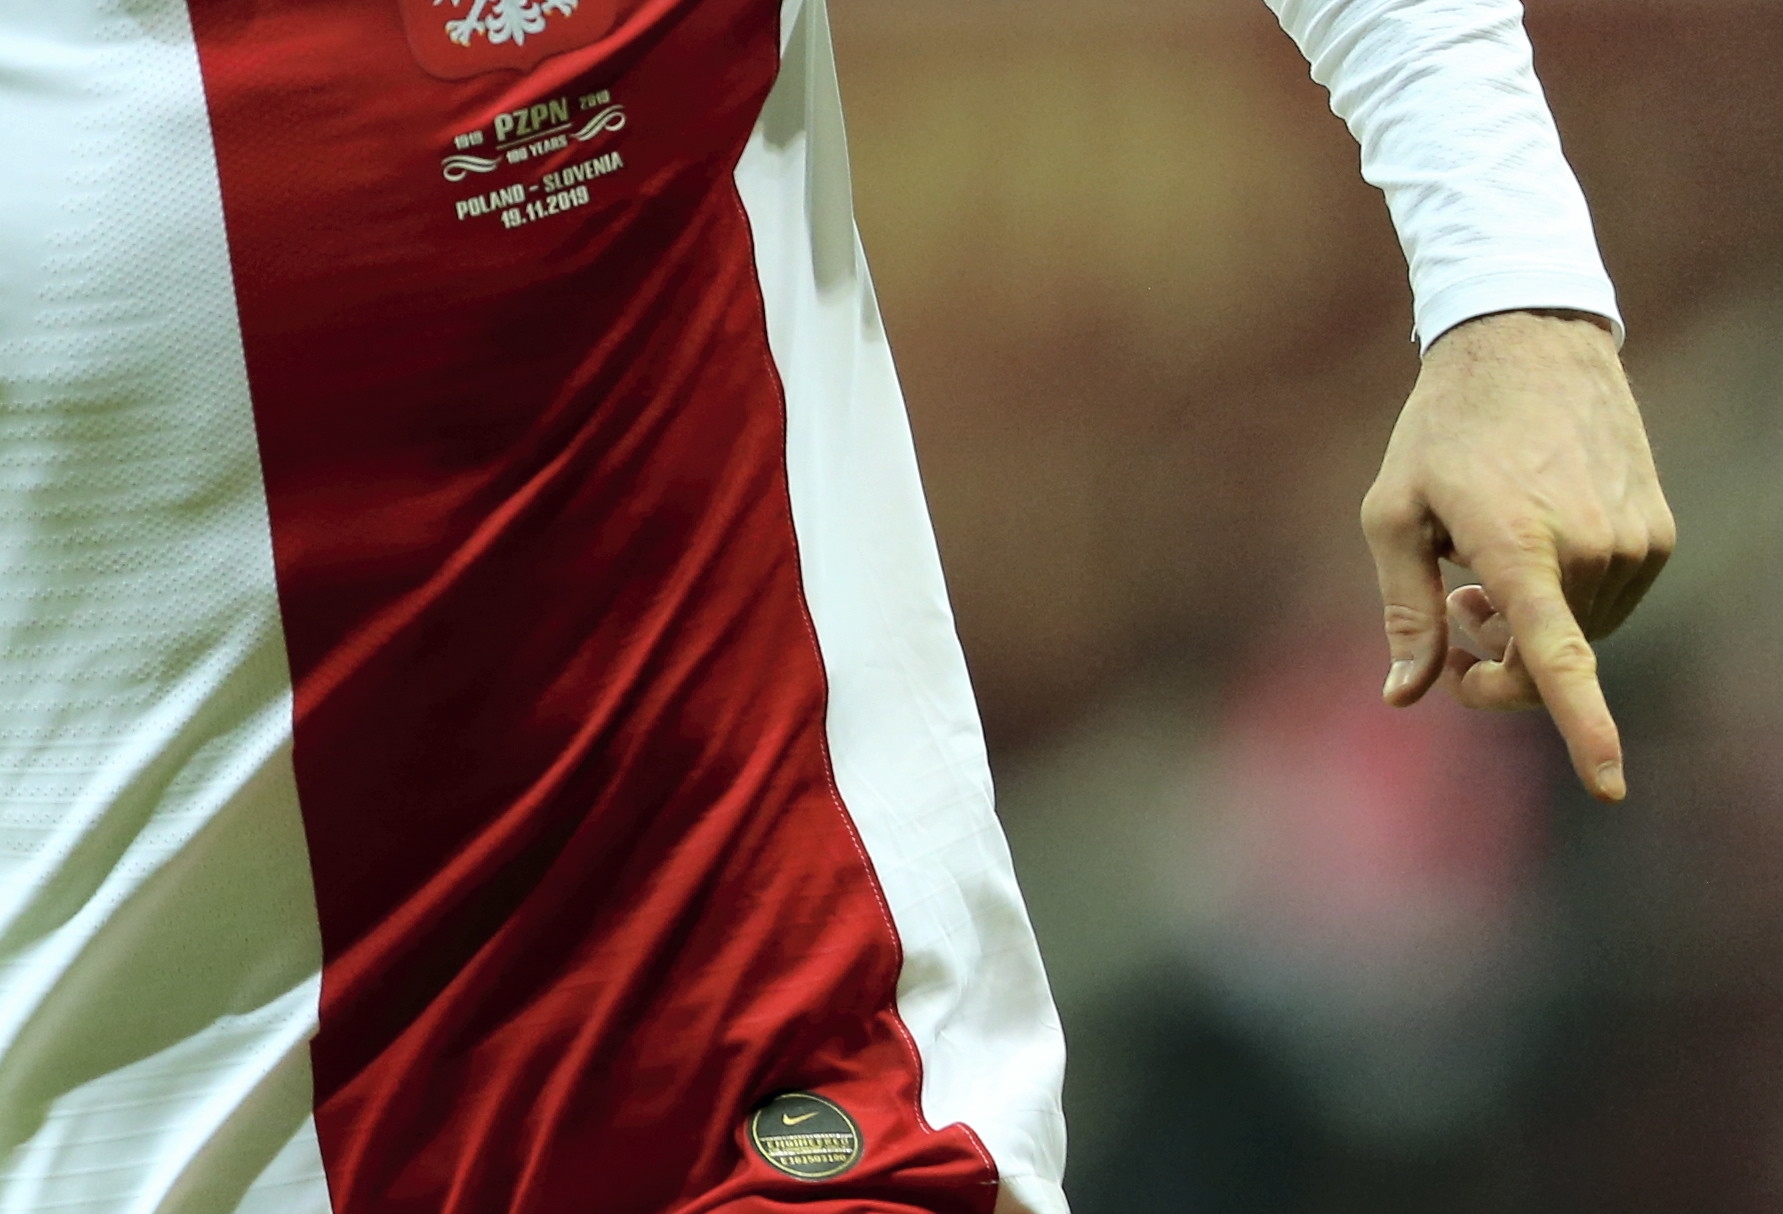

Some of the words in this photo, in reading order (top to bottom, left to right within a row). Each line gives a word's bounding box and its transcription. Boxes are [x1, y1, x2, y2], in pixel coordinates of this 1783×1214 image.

[494, 98, 568, 140] PZPN
[506, 145, 528, 164] 100
[529, 135, 568, 157] YEARS
[456, 183, 525, 220] POLAND
[542, 151, 624, 193] SLOVENIA
[501, 185, 590, 229] 19.11.2019
